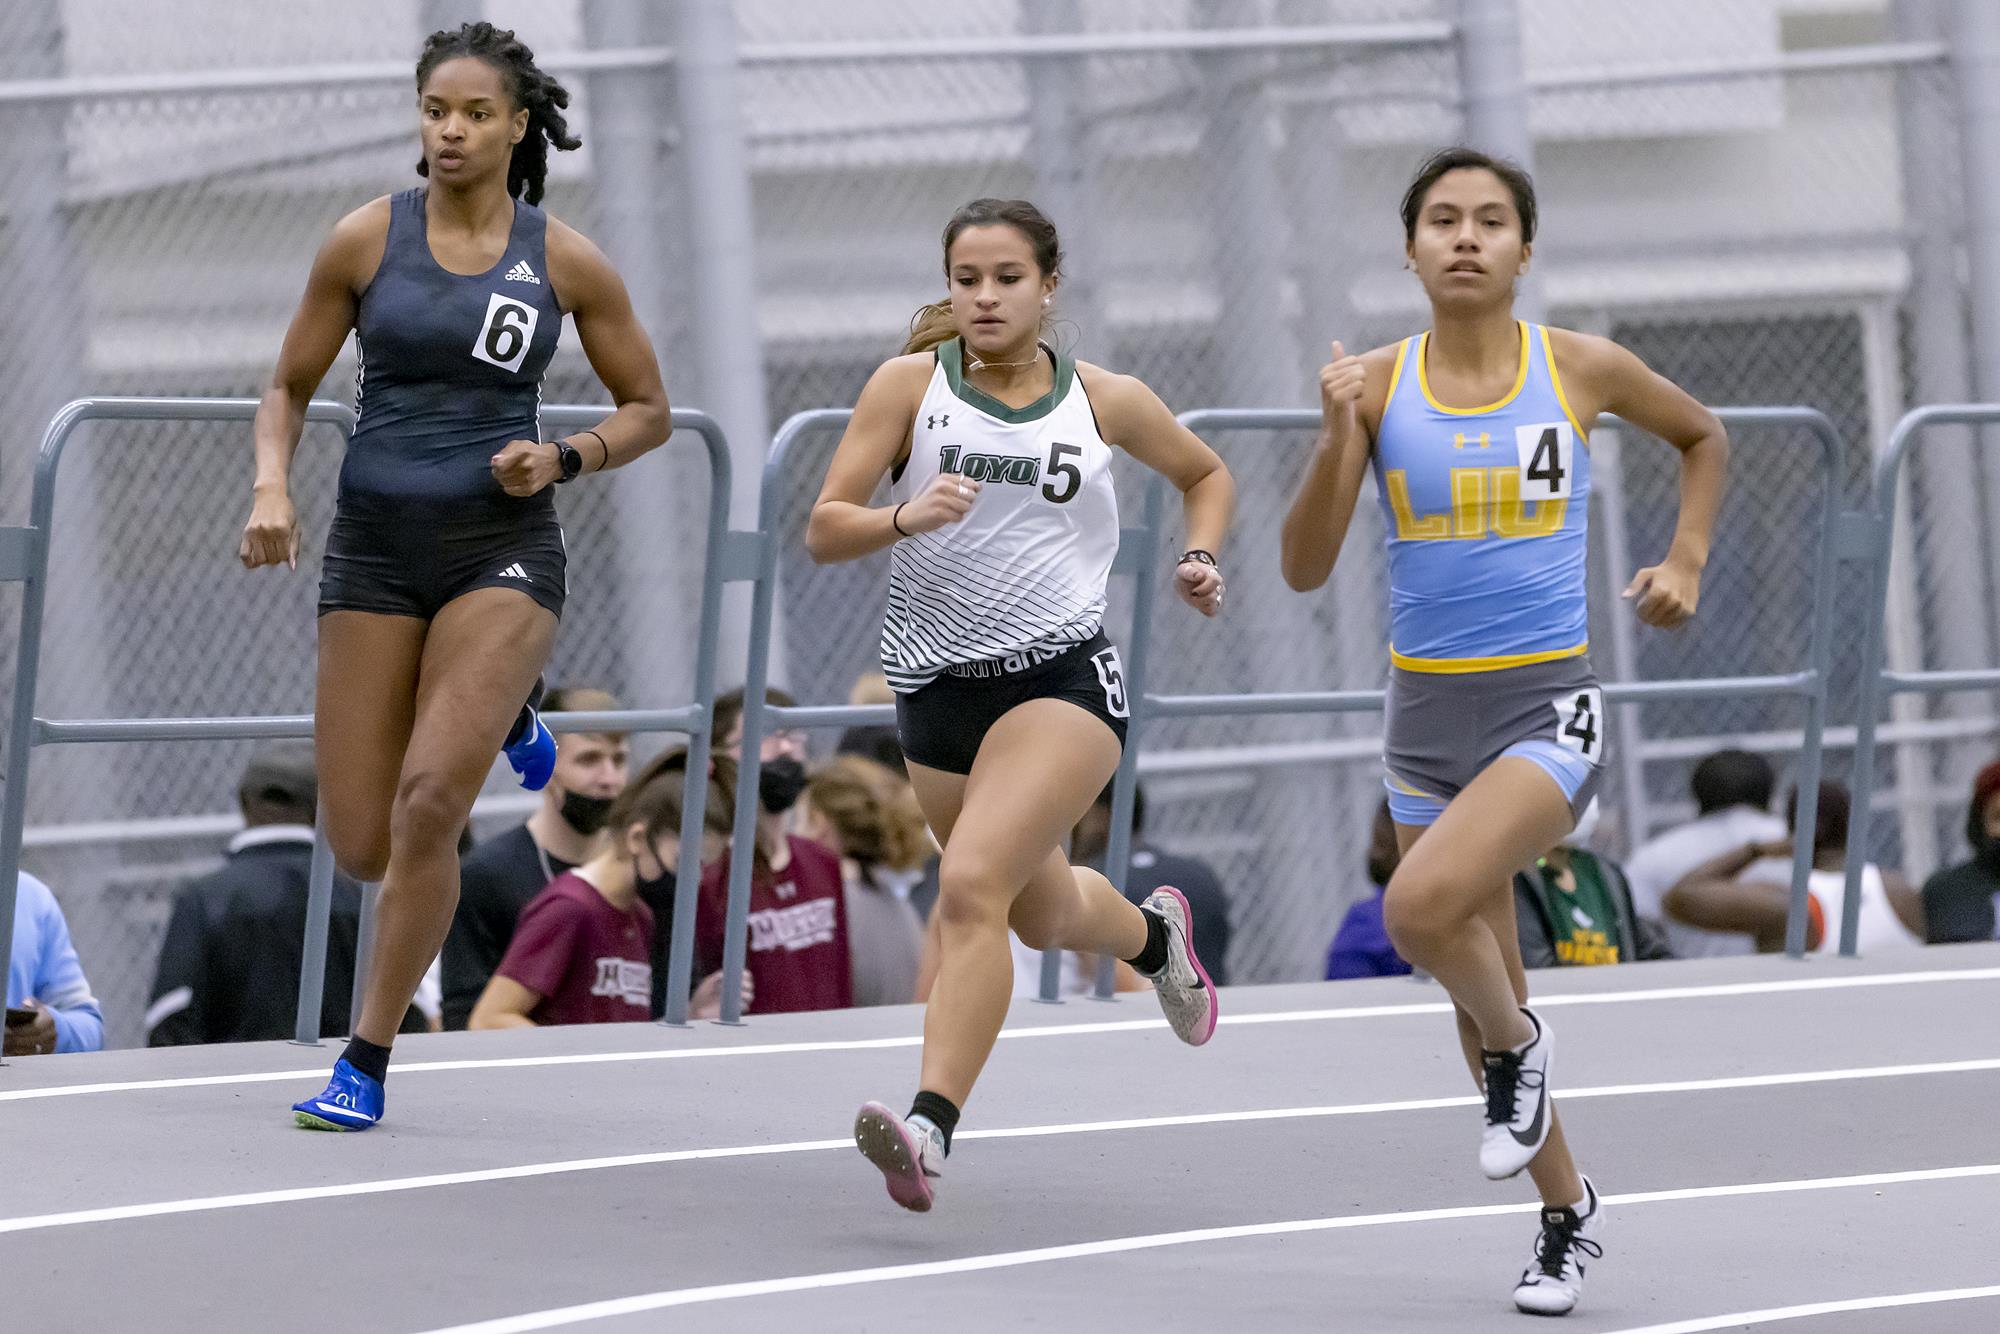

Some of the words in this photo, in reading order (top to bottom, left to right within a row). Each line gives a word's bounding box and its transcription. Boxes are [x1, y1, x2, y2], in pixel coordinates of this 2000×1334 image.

[505, 272, 540, 285] adidas
[485, 303, 529, 363] 6
[940, 444, 1041, 486] LOYO
[1041, 442, 1082, 504] 5
[1527, 427, 1566, 493] 4
[1384, 466, 1569, 541] LIU
[1096, 652, 1126, 713] 5
[1565, 694, 1597, 754] 4
